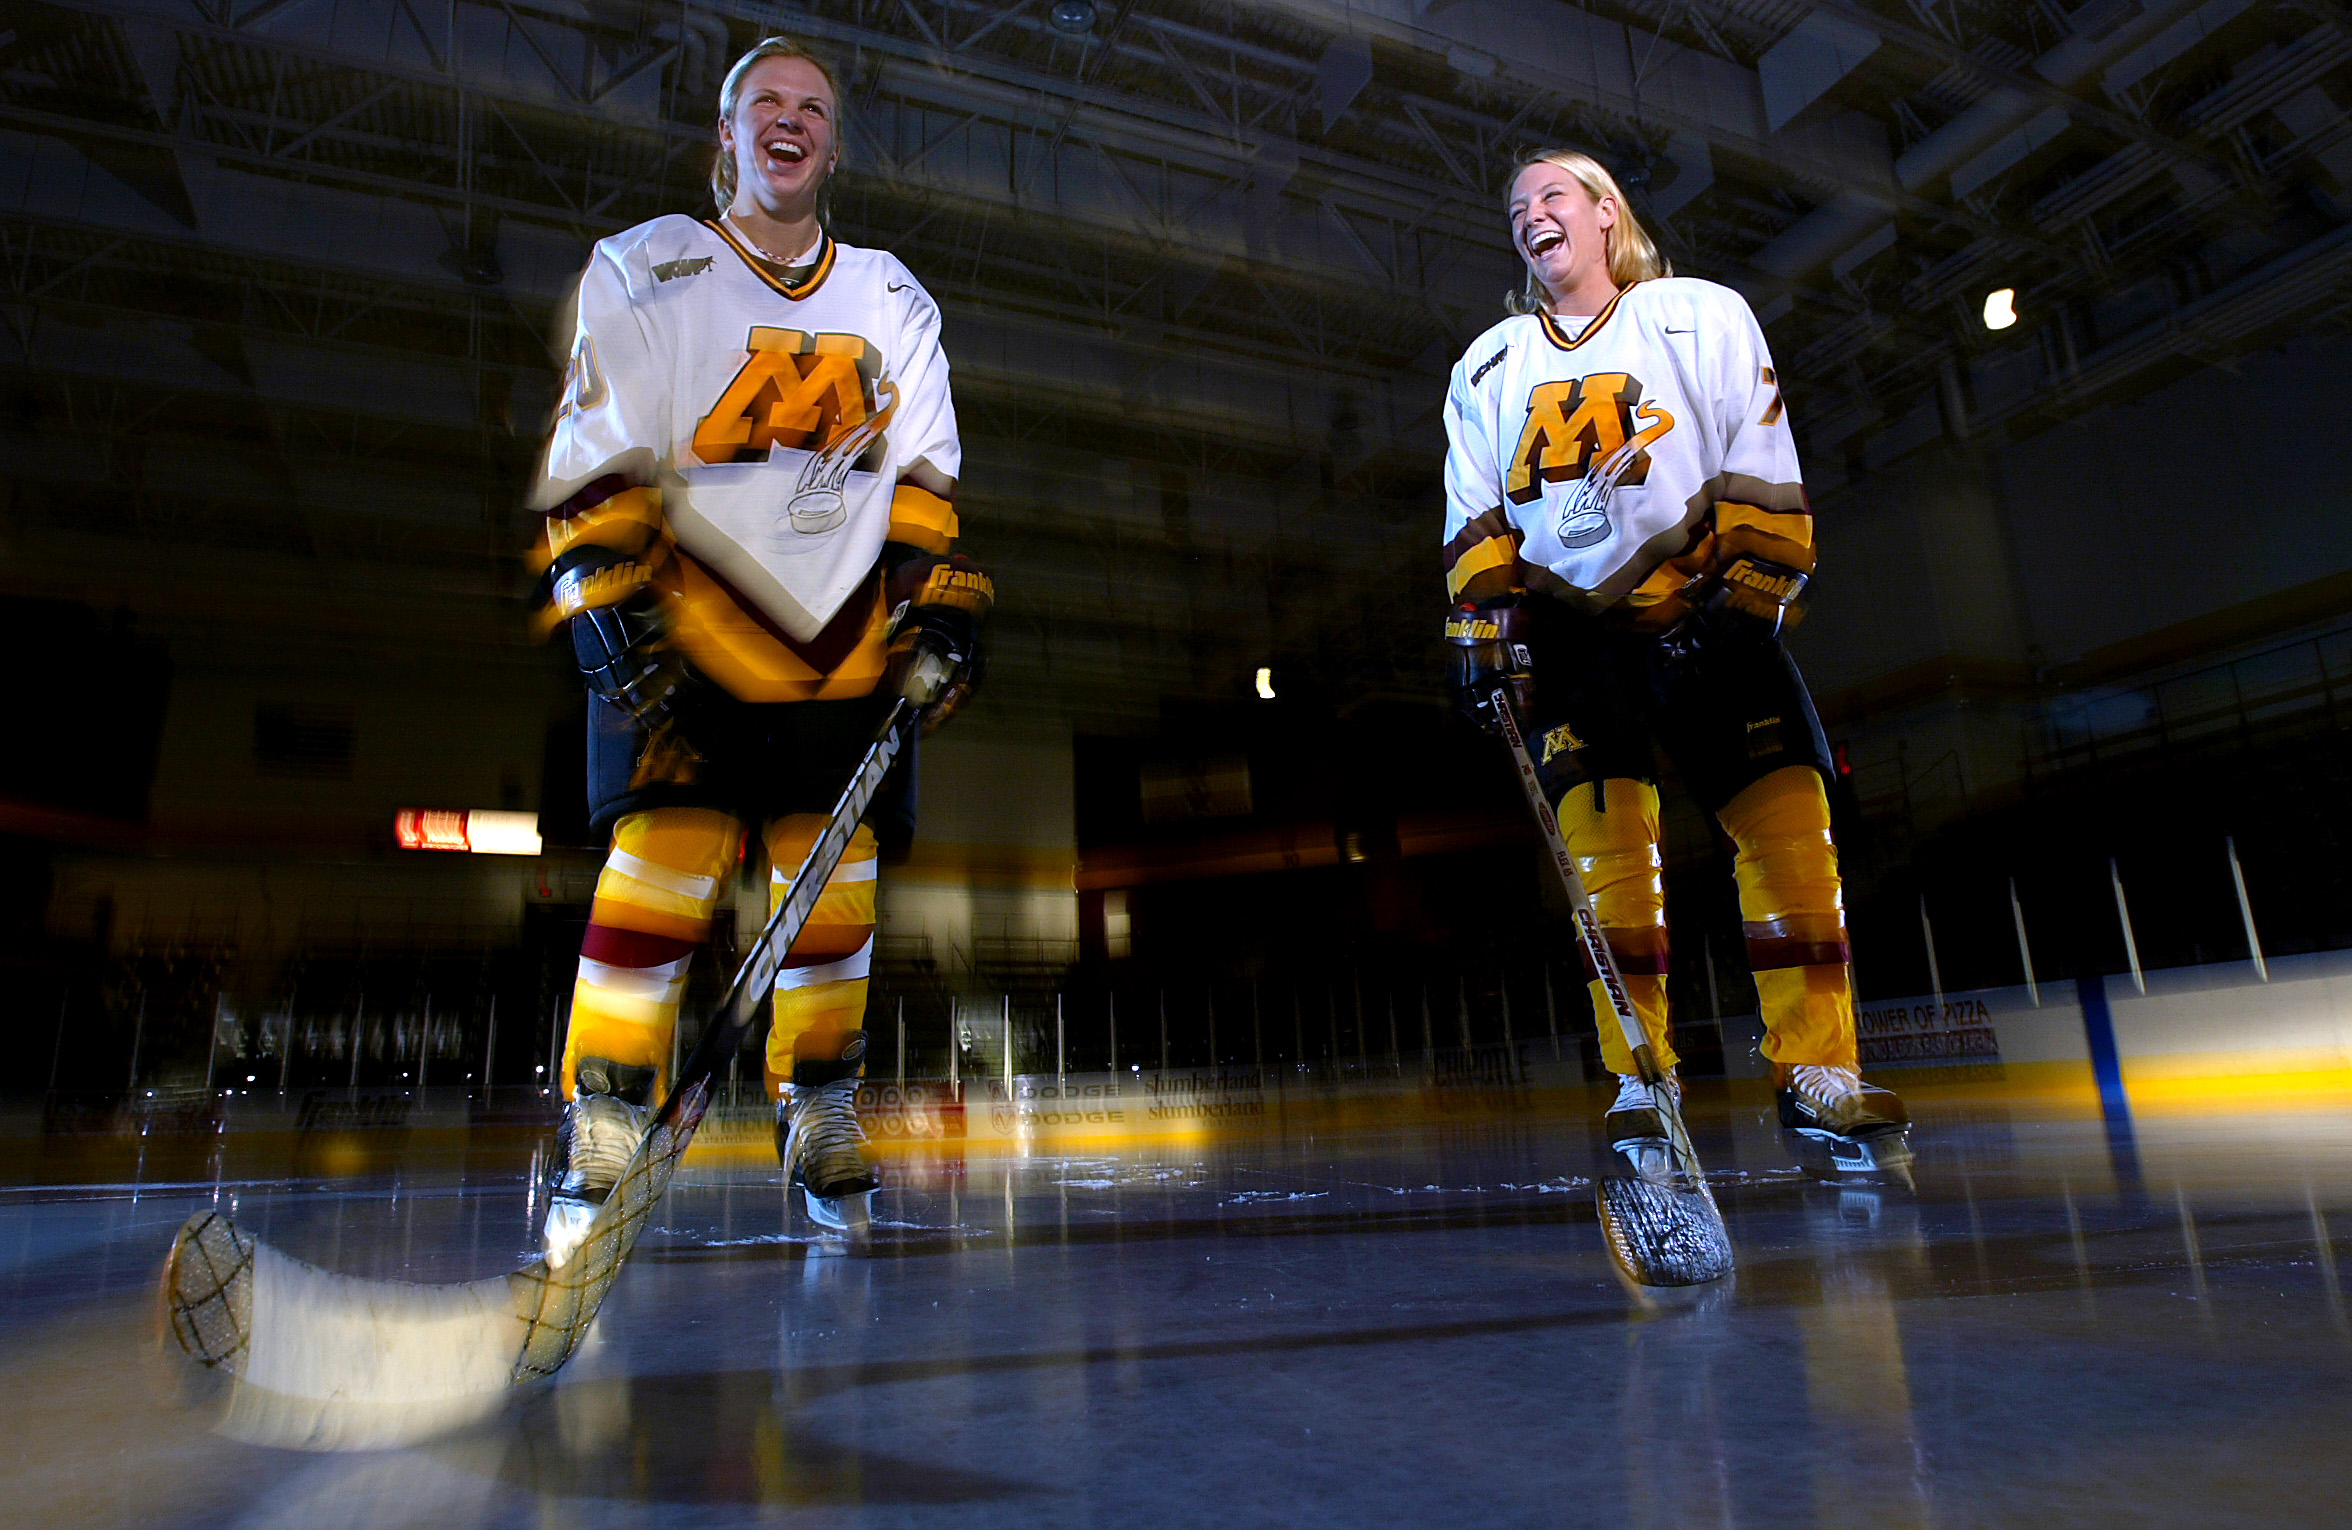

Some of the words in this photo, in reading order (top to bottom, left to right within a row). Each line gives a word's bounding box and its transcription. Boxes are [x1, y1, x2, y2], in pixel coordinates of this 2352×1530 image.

[749, 724, 901, 1002] CHRSTIAN
[1577, 908, 1633, 1017] CHRISTIAN
[1914, 1003, 1936, 1030] OF
